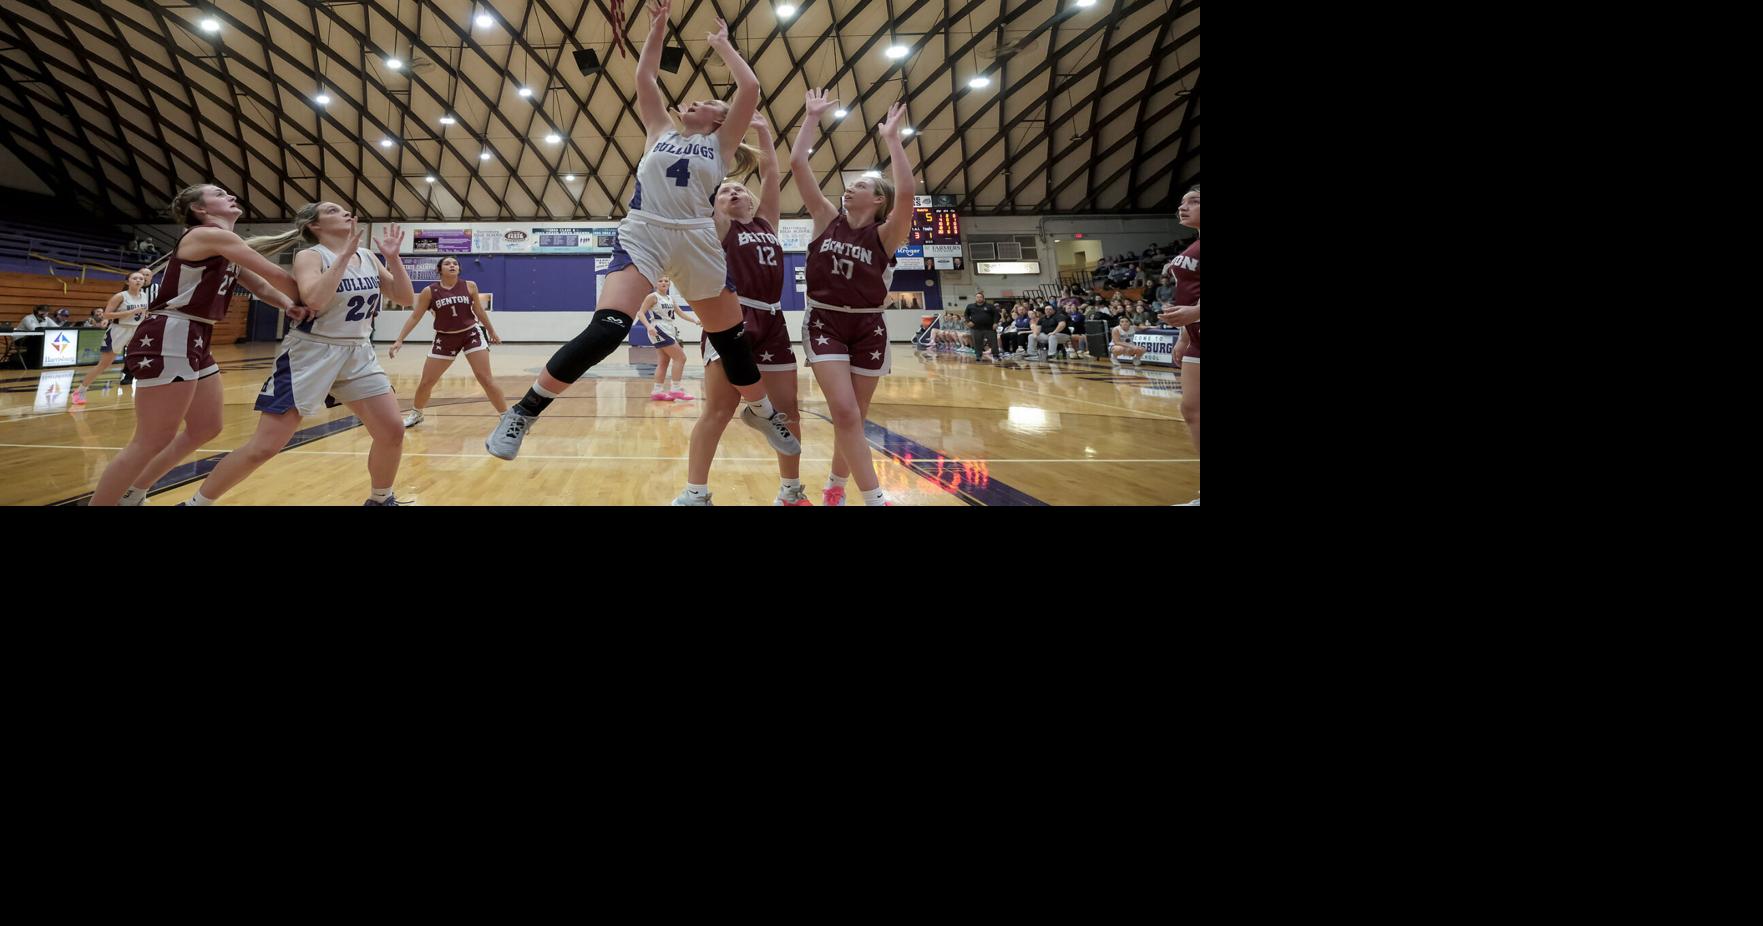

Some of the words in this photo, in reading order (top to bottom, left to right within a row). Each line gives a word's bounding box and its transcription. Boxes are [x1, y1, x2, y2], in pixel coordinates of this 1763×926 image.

[652, 142, 714, 160] BULLDOGS
[665, 158, 691, 187] 4
[925, 212, 933, 222] 5
[756, 245, 777, 266] 12
[819, 237, 872, 265] BENTON
[831, 254, 855, 280] 10
[1170, 255, 1199, 272] ON
[345, 293, 379, 321] 22
[435, 295, 470, 309] BENTON
[450, 305, 458, 317] 1
